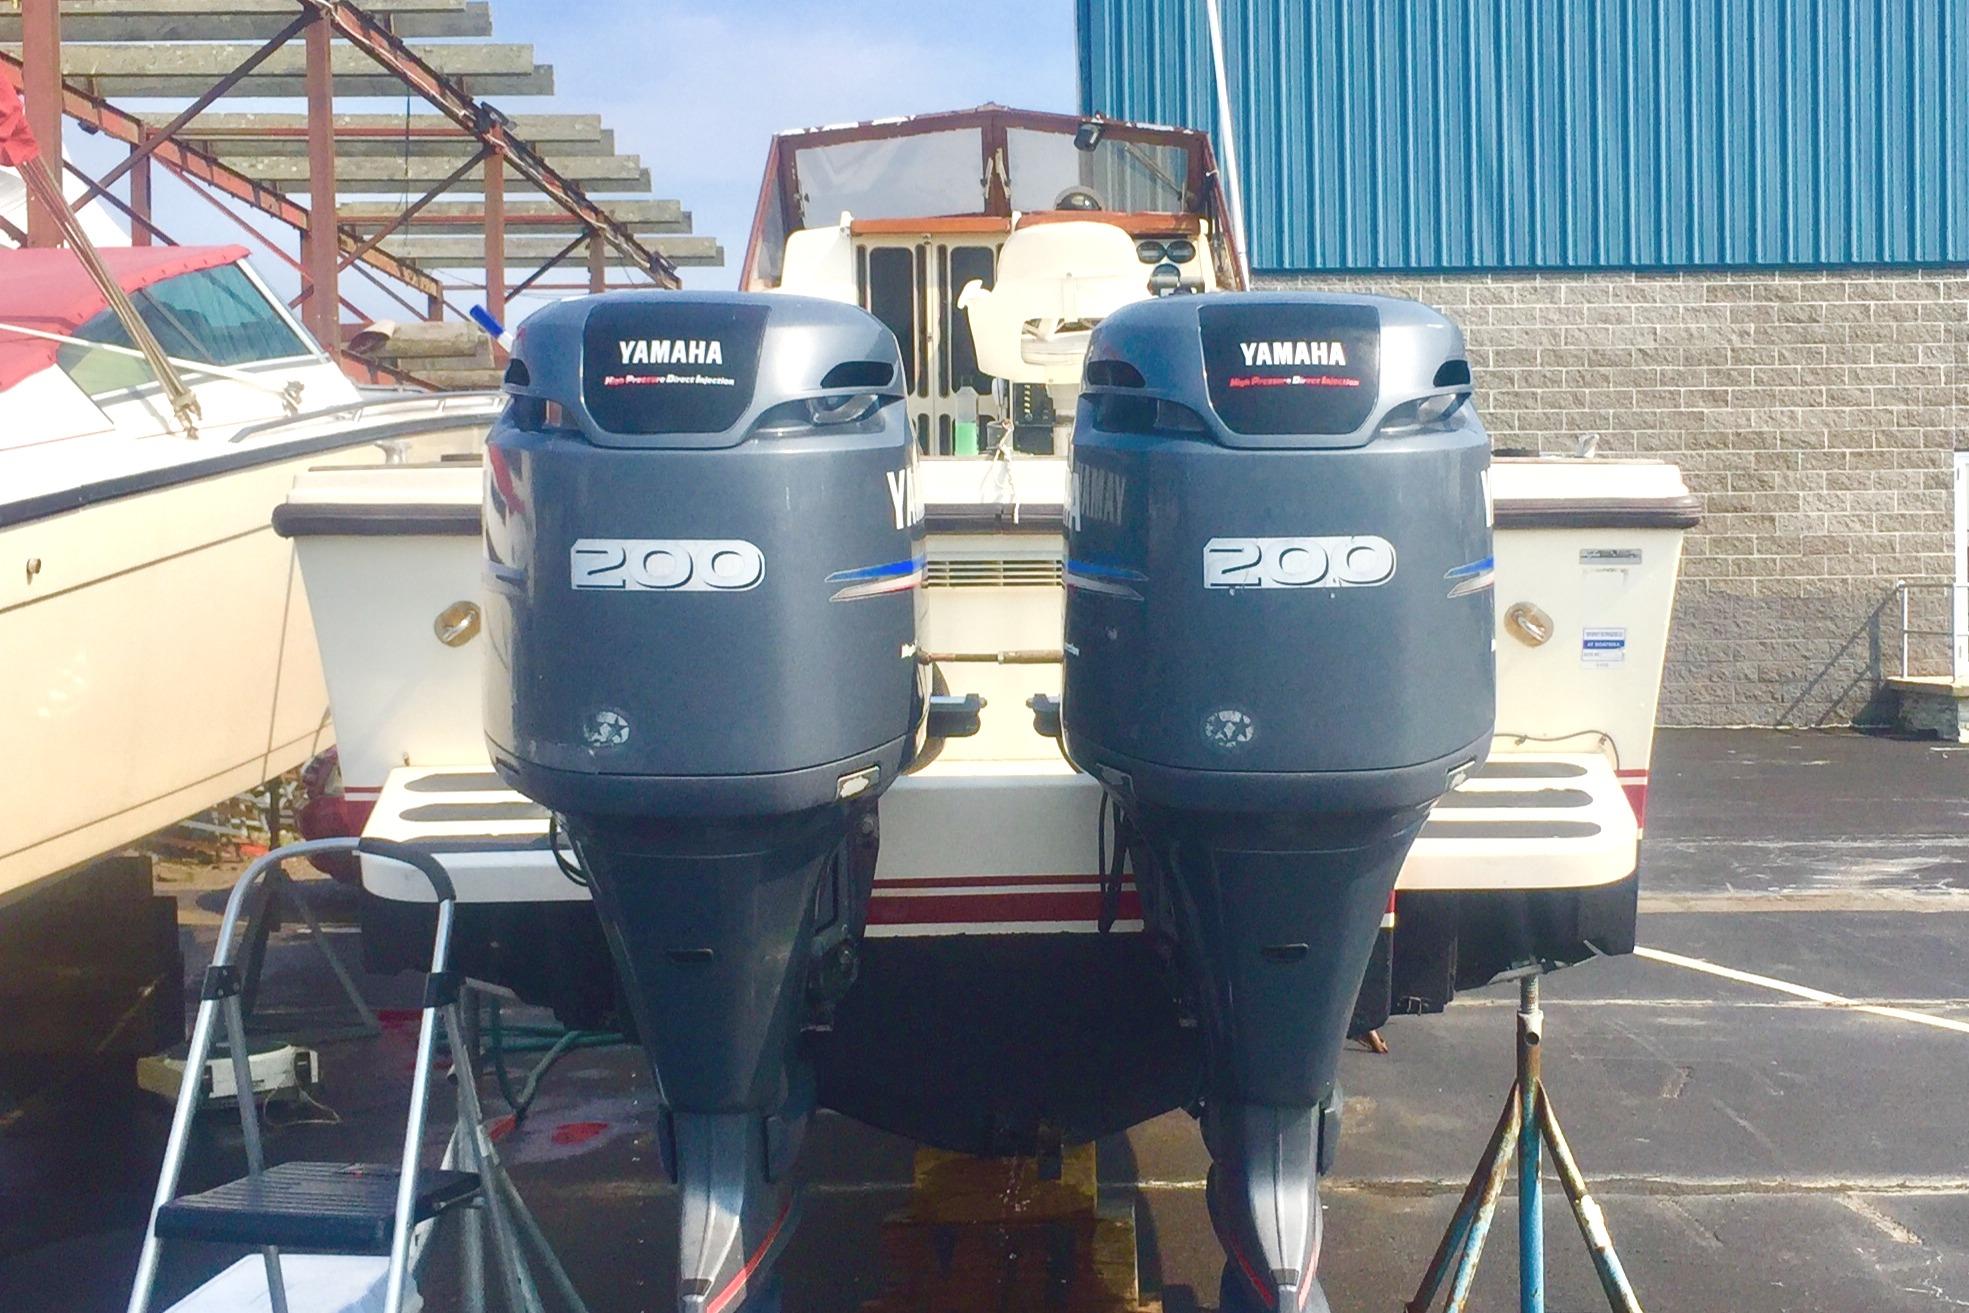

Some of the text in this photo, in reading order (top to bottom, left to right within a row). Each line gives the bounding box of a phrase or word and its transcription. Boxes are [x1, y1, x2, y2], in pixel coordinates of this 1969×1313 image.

[619, 340, 723, 365] YAMAHA
[1240, 341, 1346, 366] YAMAHA
[666, 374, 695, 384] Direct
[695, 375, 735, 386] Injection
[1291, 375, 1320, 385] Direct
[1321, 376, 1360, 386] Injection
[572, 539, 765, 591] 200
[1204, 536, 1396, 588] 200
